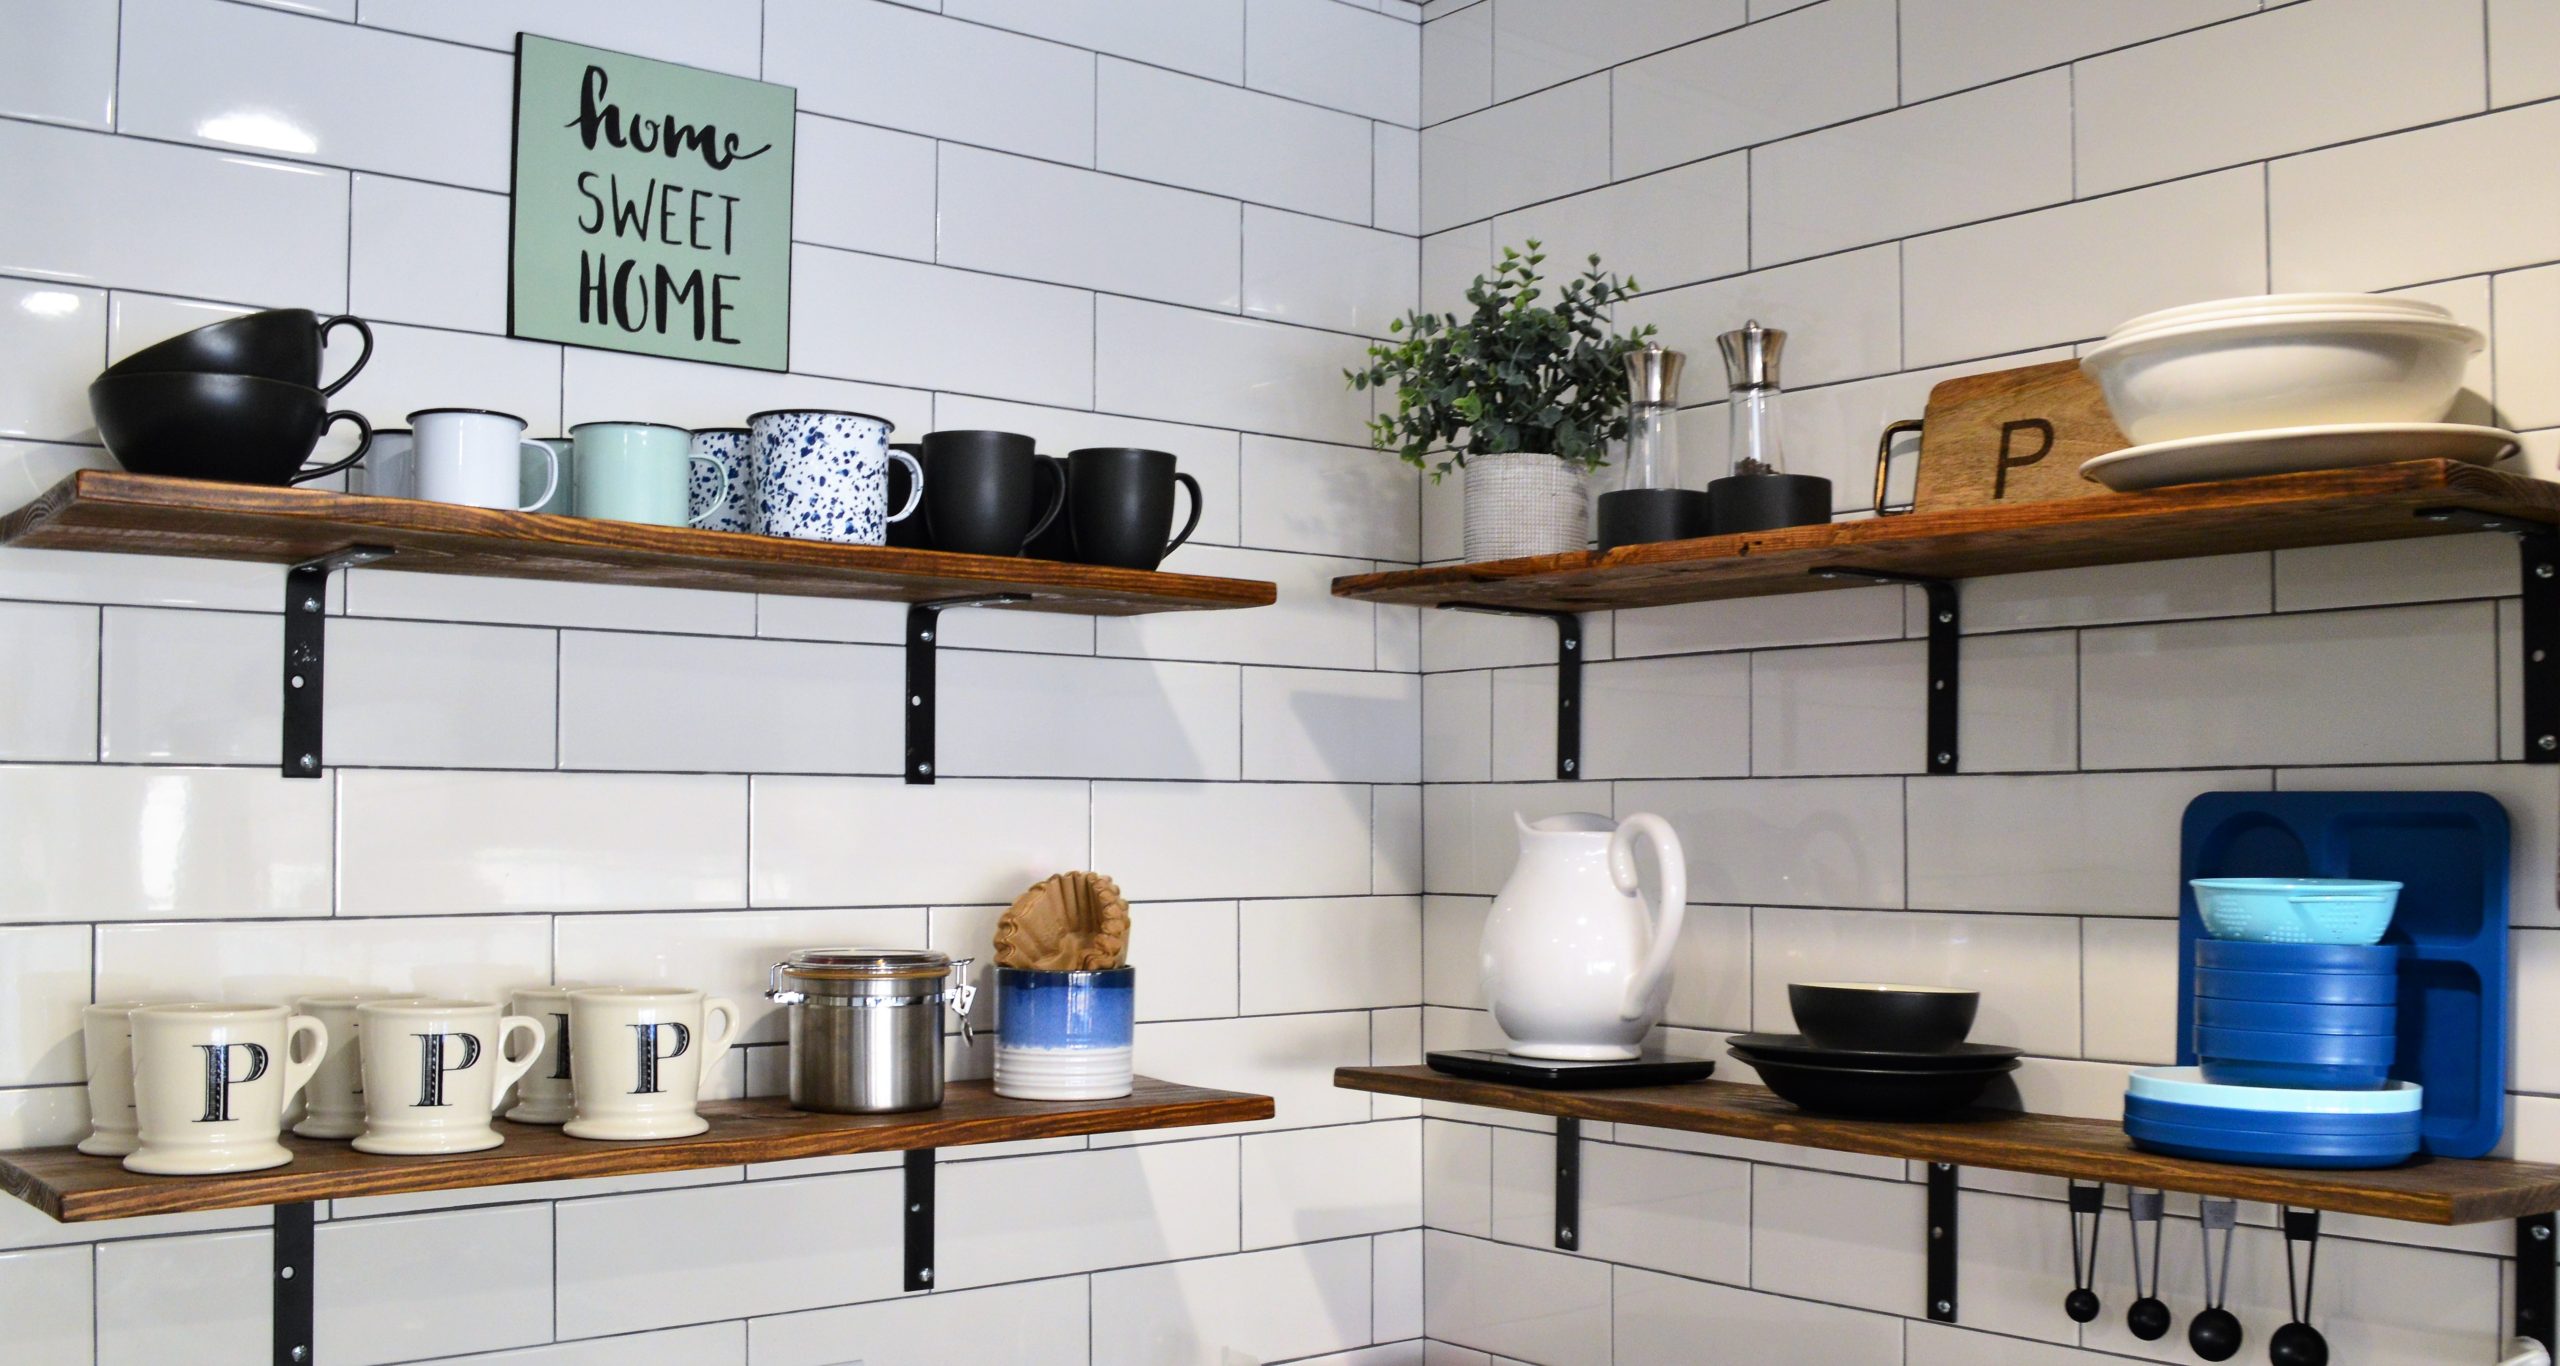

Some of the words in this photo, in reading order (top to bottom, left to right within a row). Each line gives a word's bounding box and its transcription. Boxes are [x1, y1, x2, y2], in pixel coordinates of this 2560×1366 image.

[564, 65, 772, 170] home
[577, 171, 741, 255] SWEET
[579, 250, 741, 345] HOME
[1993, 418, 2055, 500] P
[191, 1042, 269, 1123] P
[408, 1032, 482, 1107] P
[625, 1022, 691, 1094] P
